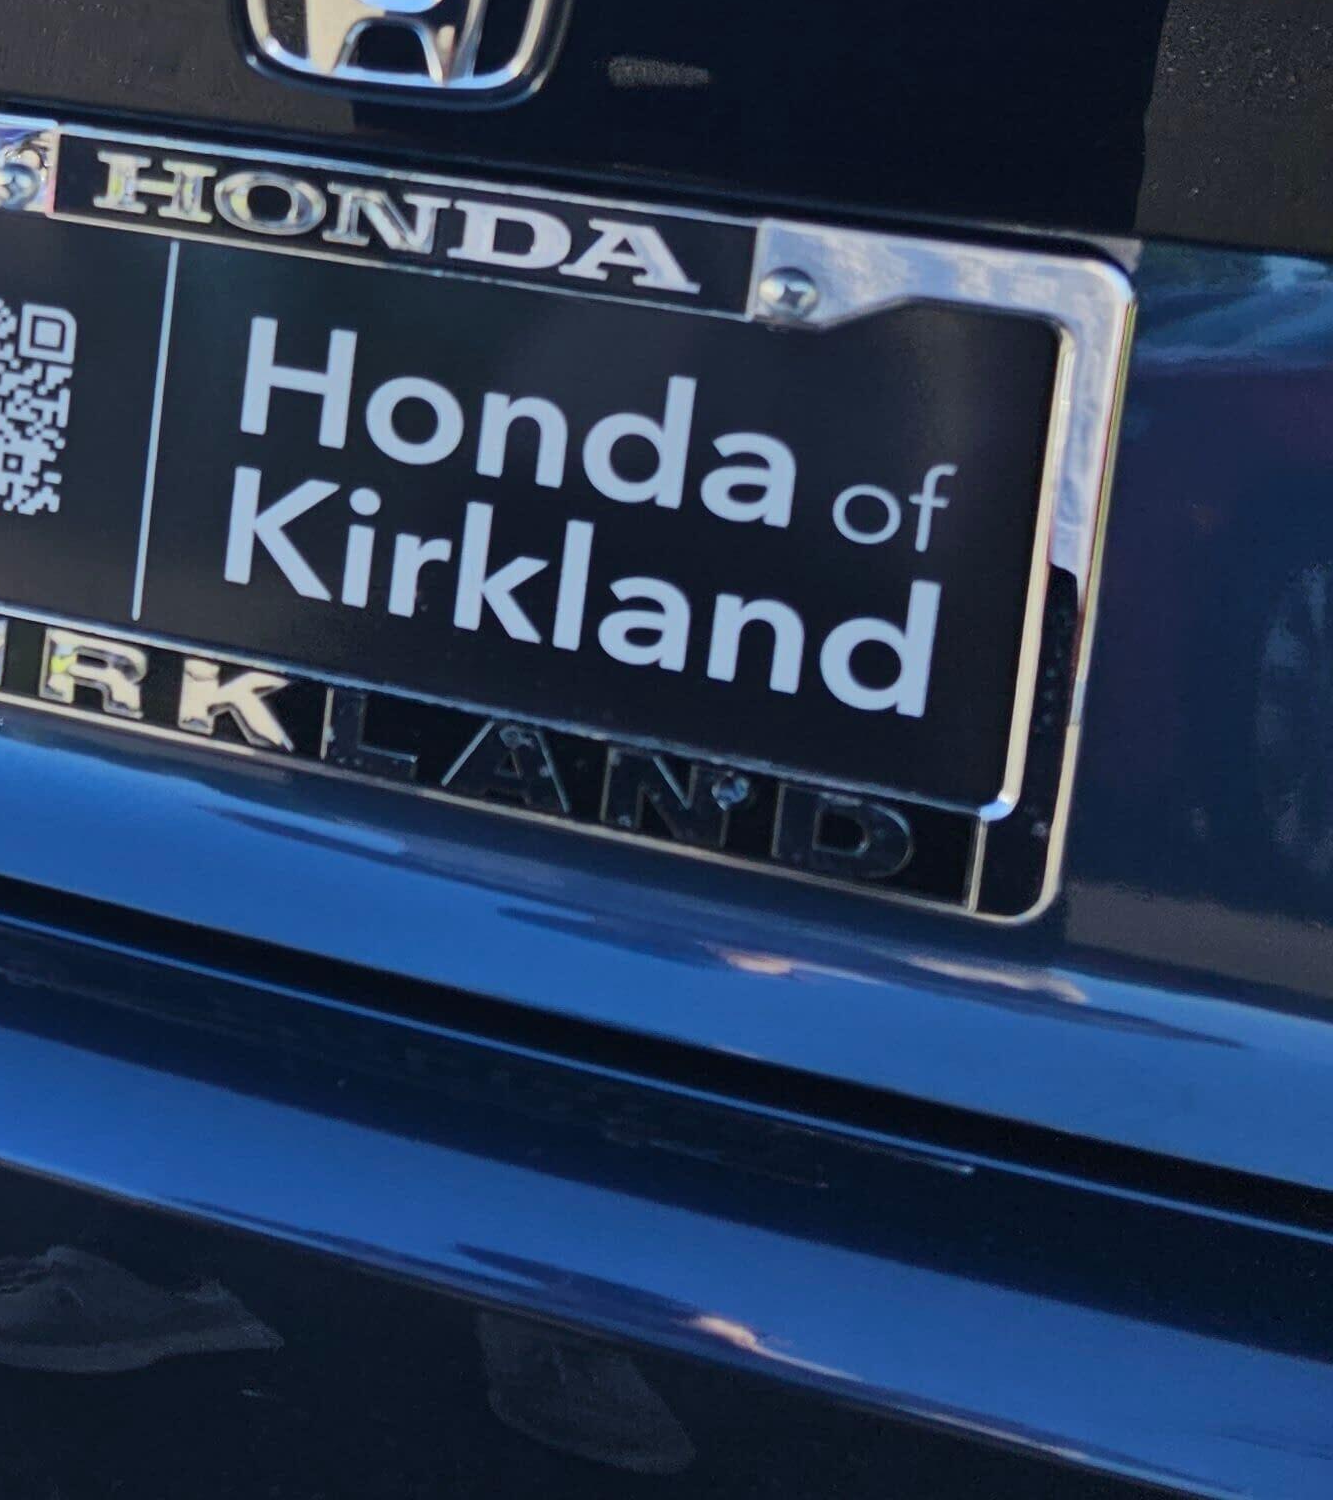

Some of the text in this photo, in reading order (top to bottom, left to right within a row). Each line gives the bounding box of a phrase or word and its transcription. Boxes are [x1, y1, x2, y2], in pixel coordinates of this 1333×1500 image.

[93, 151, 700, 294] HONDA
[240, 316, 958, 553] Honda of
[223, 466, 942, 719] Kirkland
